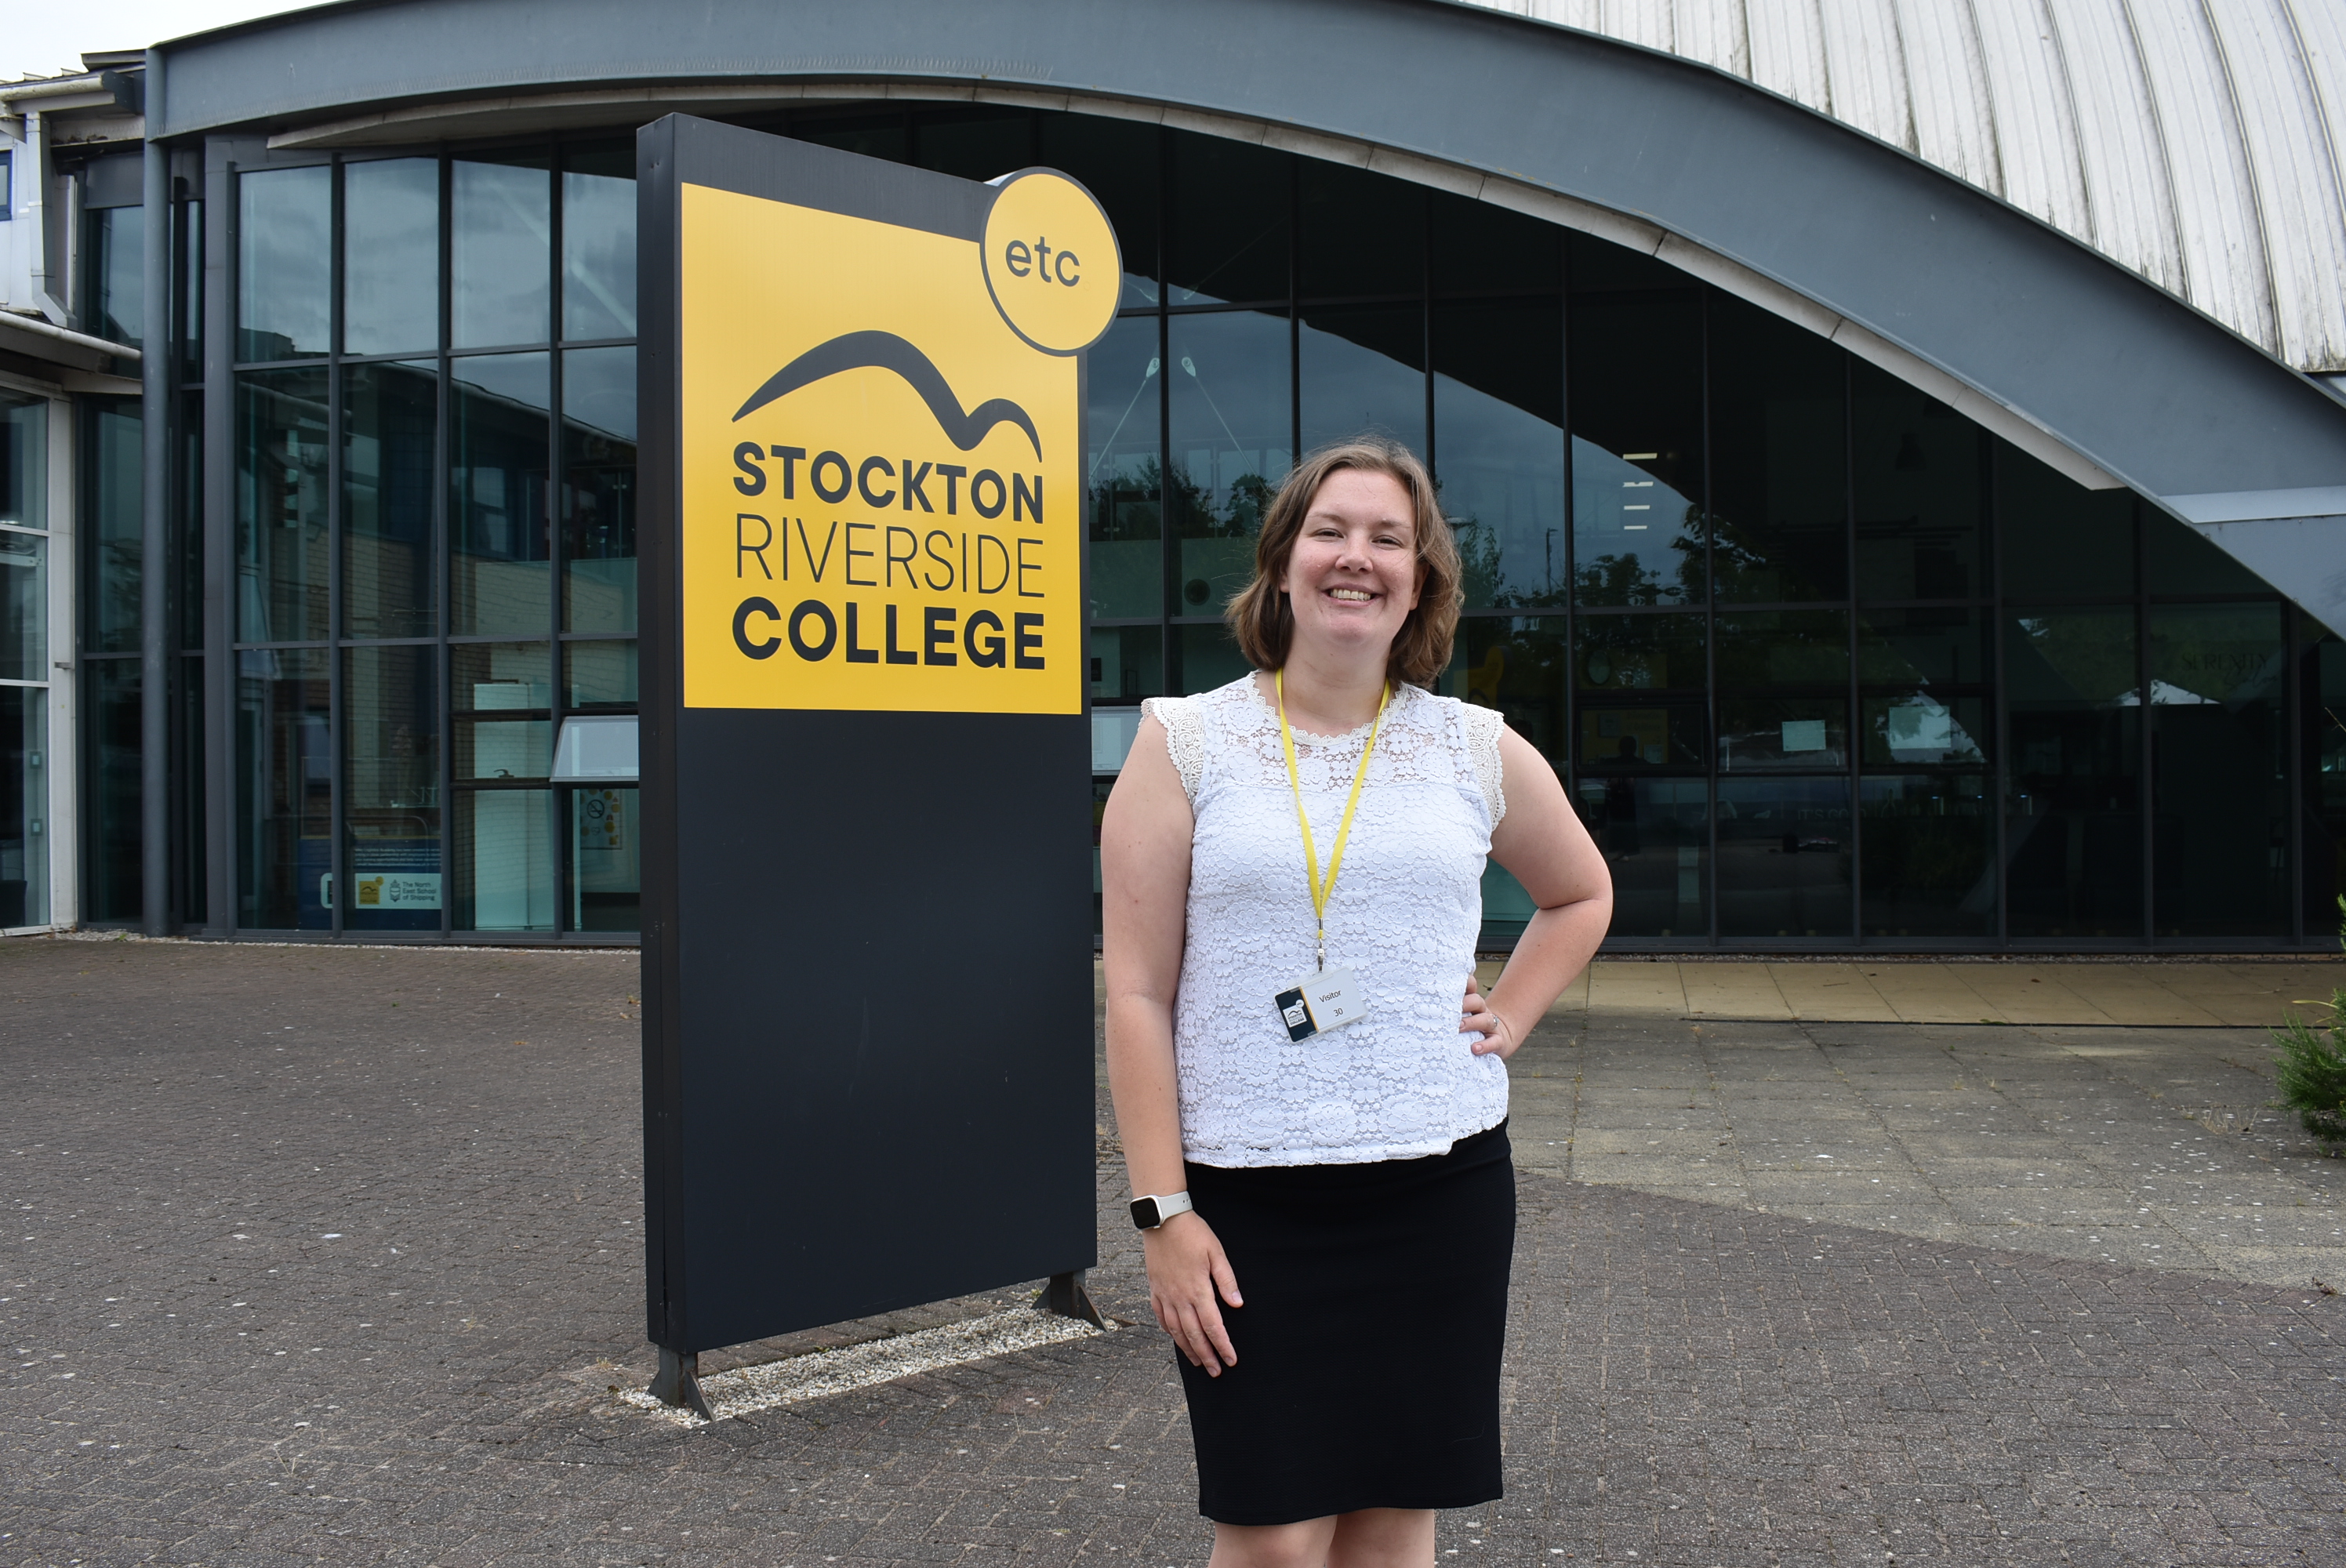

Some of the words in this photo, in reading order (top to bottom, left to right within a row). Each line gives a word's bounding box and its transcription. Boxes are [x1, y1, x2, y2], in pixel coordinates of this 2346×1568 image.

[1005, 236, 1080, 287] etc
[733, 441, 1044, 524] STOCKTON
[736, 513, 1045, 598] RIVERSIDE
[732, 596, 1045, 670] COLLEGE
[1318, 989, 1342, 1004] Visitor
[1333, 1007, 1344, 1018] 30
